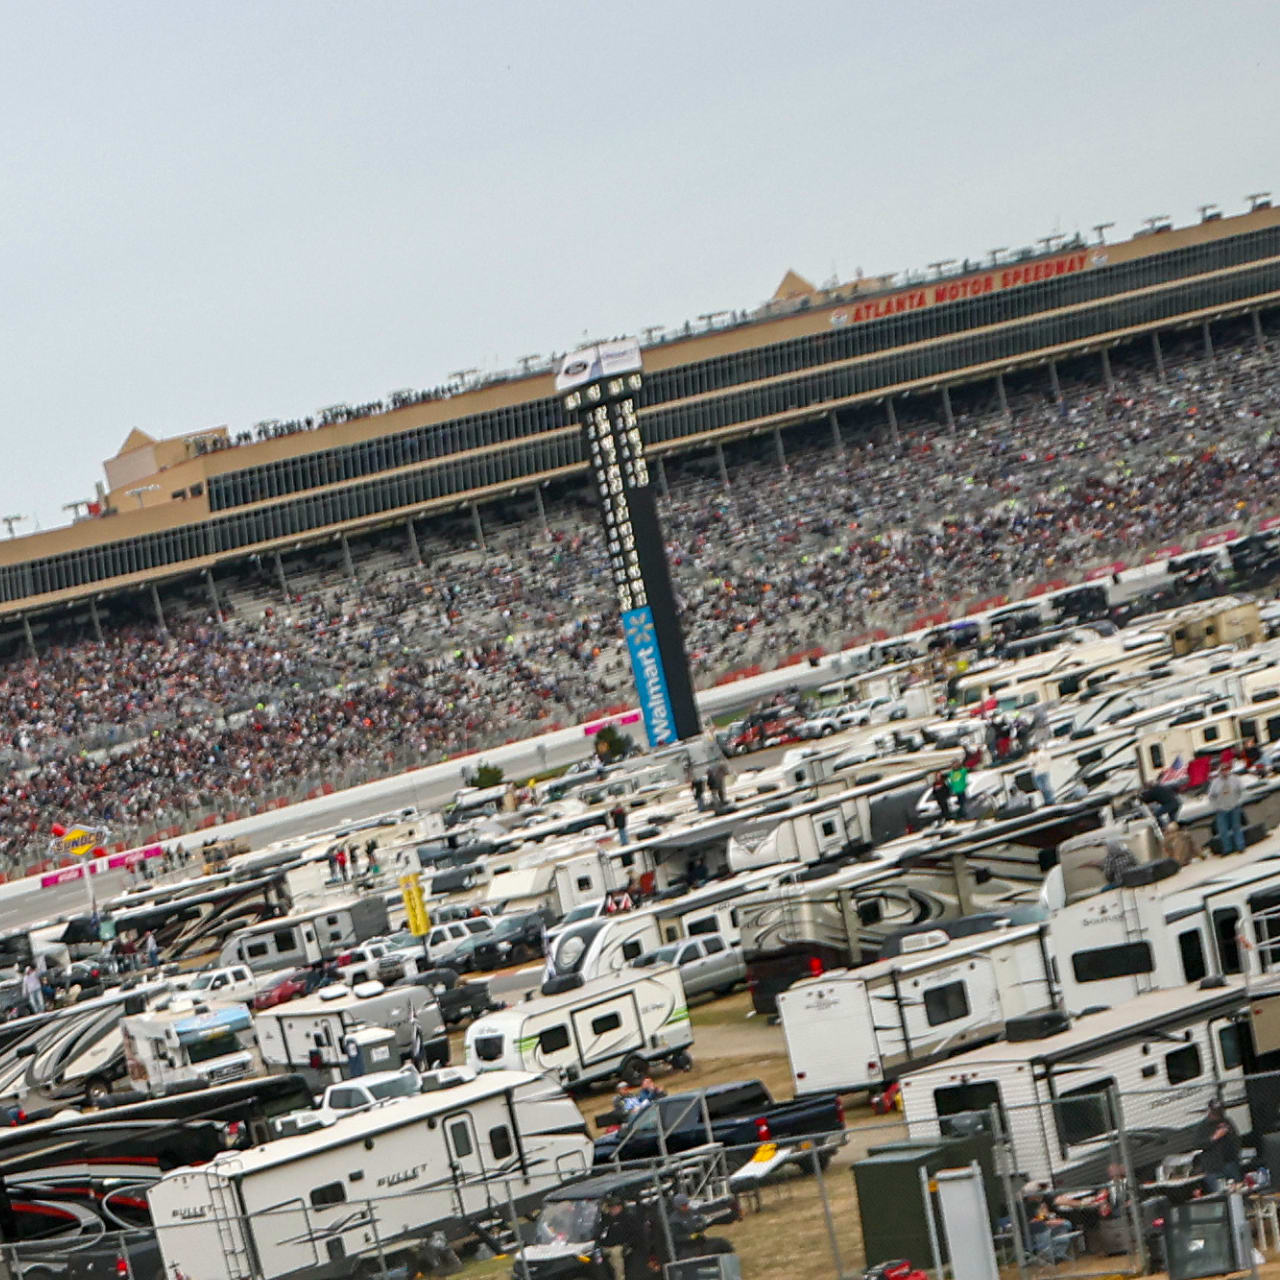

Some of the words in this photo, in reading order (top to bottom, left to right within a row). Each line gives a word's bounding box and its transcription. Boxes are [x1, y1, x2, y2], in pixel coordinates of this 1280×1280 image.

[853, 291, 927, 322] ATLANTA
[934, 275, 994, 304] MOTOR
[1000, 254, 1089, 290] SPEEDWAY
[637, 645, 673, 743] Walmart
[377, 1163, 428, 1187] BULLET
[171, 1205, 216, 1219] BULLET
